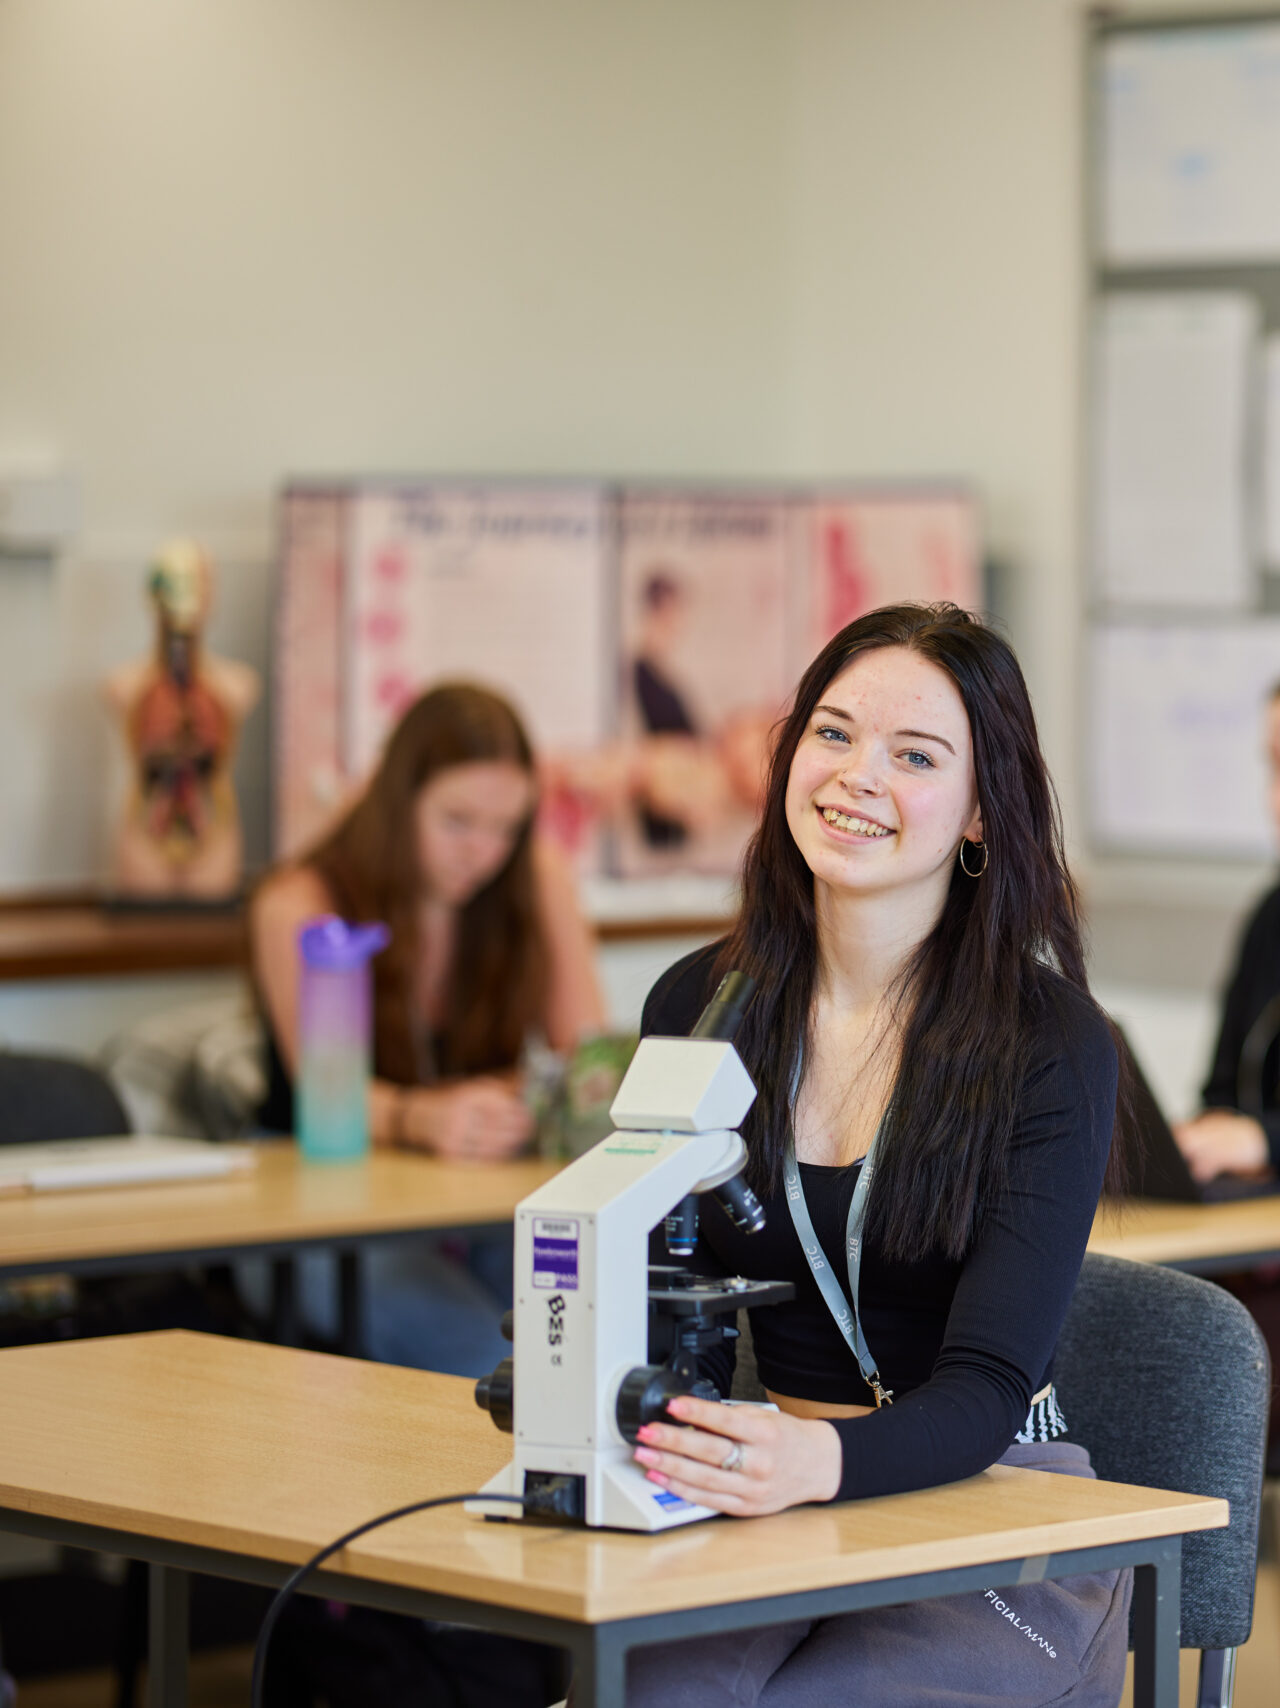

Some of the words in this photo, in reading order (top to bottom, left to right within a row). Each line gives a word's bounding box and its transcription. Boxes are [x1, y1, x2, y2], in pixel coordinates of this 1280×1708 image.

[786, 1175, 800, 1201] BTC
[806, 1245, 825, 1270] BTC
[849, 1237, 858, 1263] BTC
[548, 1294, 566, 1346] BMS
[837, 1309, 855, 1335] BTC
